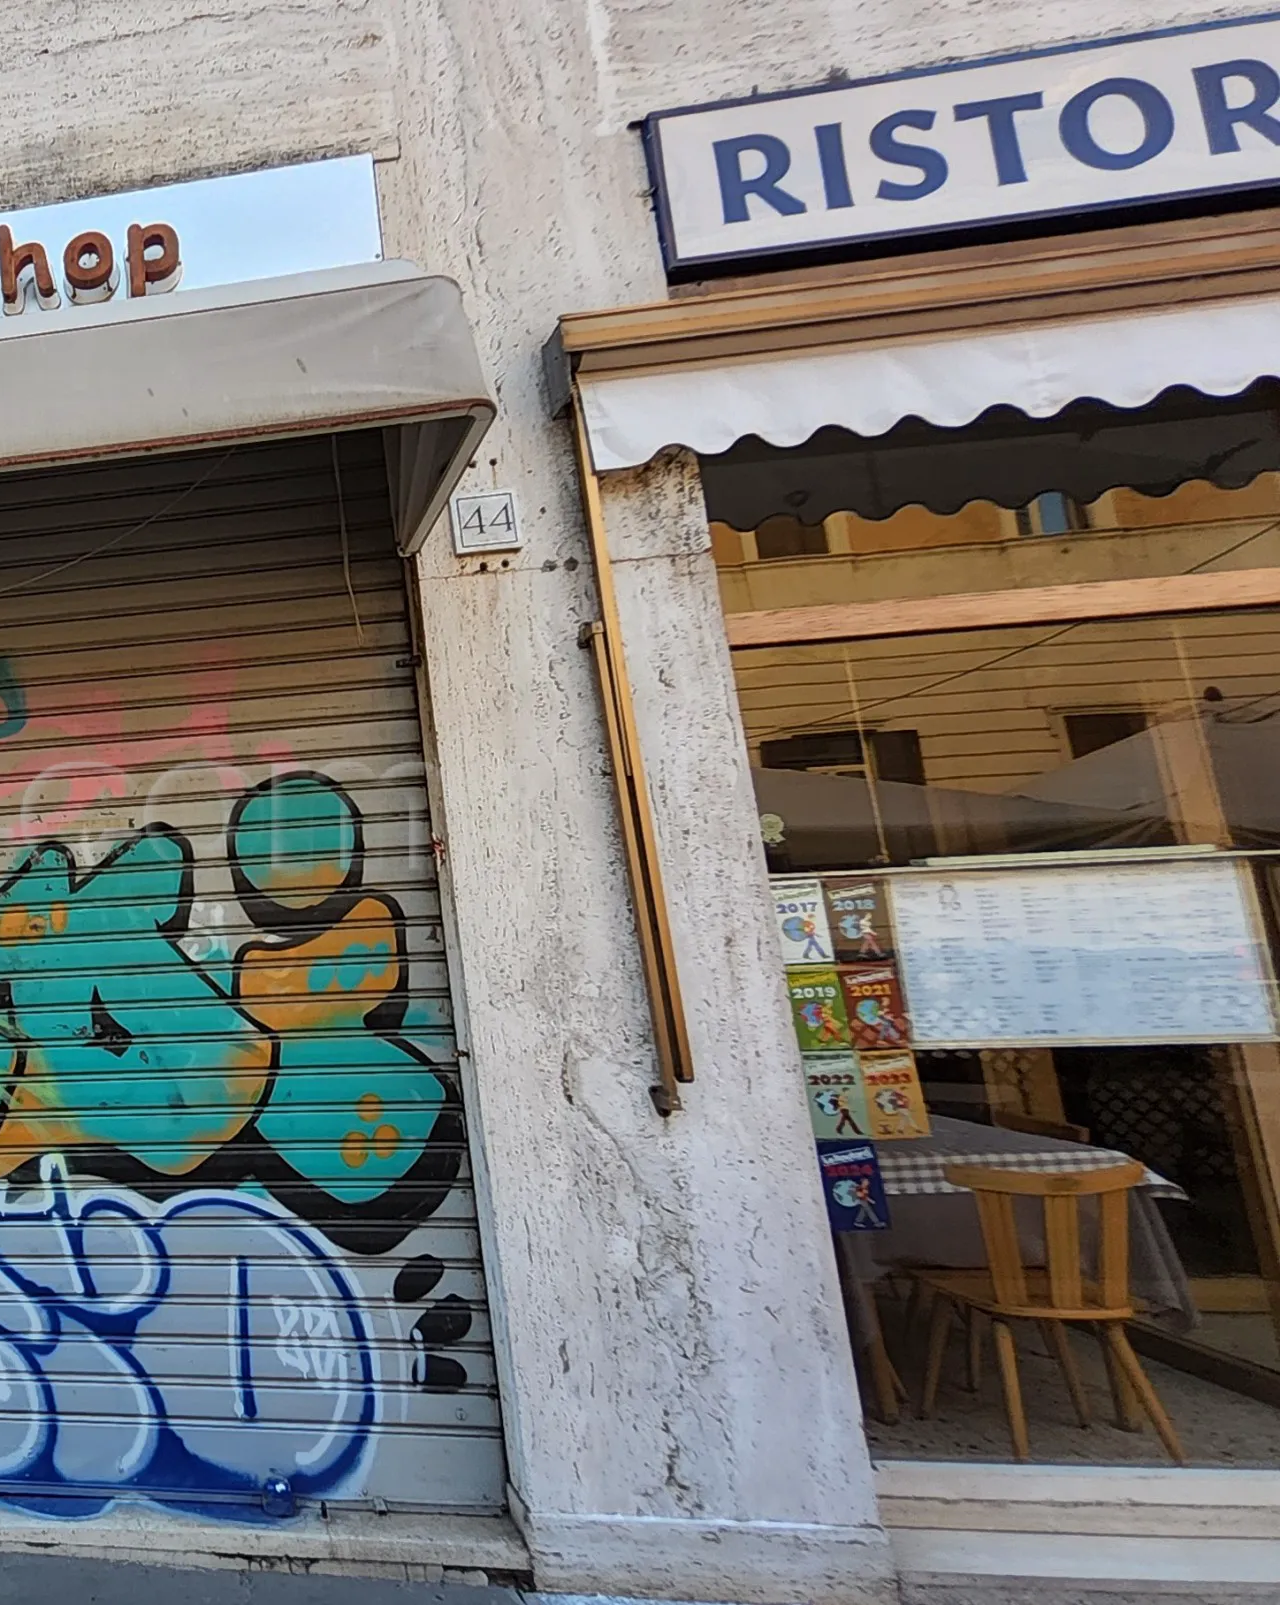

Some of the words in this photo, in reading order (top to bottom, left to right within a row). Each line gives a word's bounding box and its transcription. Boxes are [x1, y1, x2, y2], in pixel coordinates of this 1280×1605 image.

[712, 58, 1280, 226] RISTOR
[462, 503, 515, 536] 44
[775, 901, 818, 914] 2017
[832, 899, 877, 912] 2018
[791, 986, 837, 999] 2019
[850, 984, 892, 997] 2021
[807, 1073, 856, 1086] 2022
